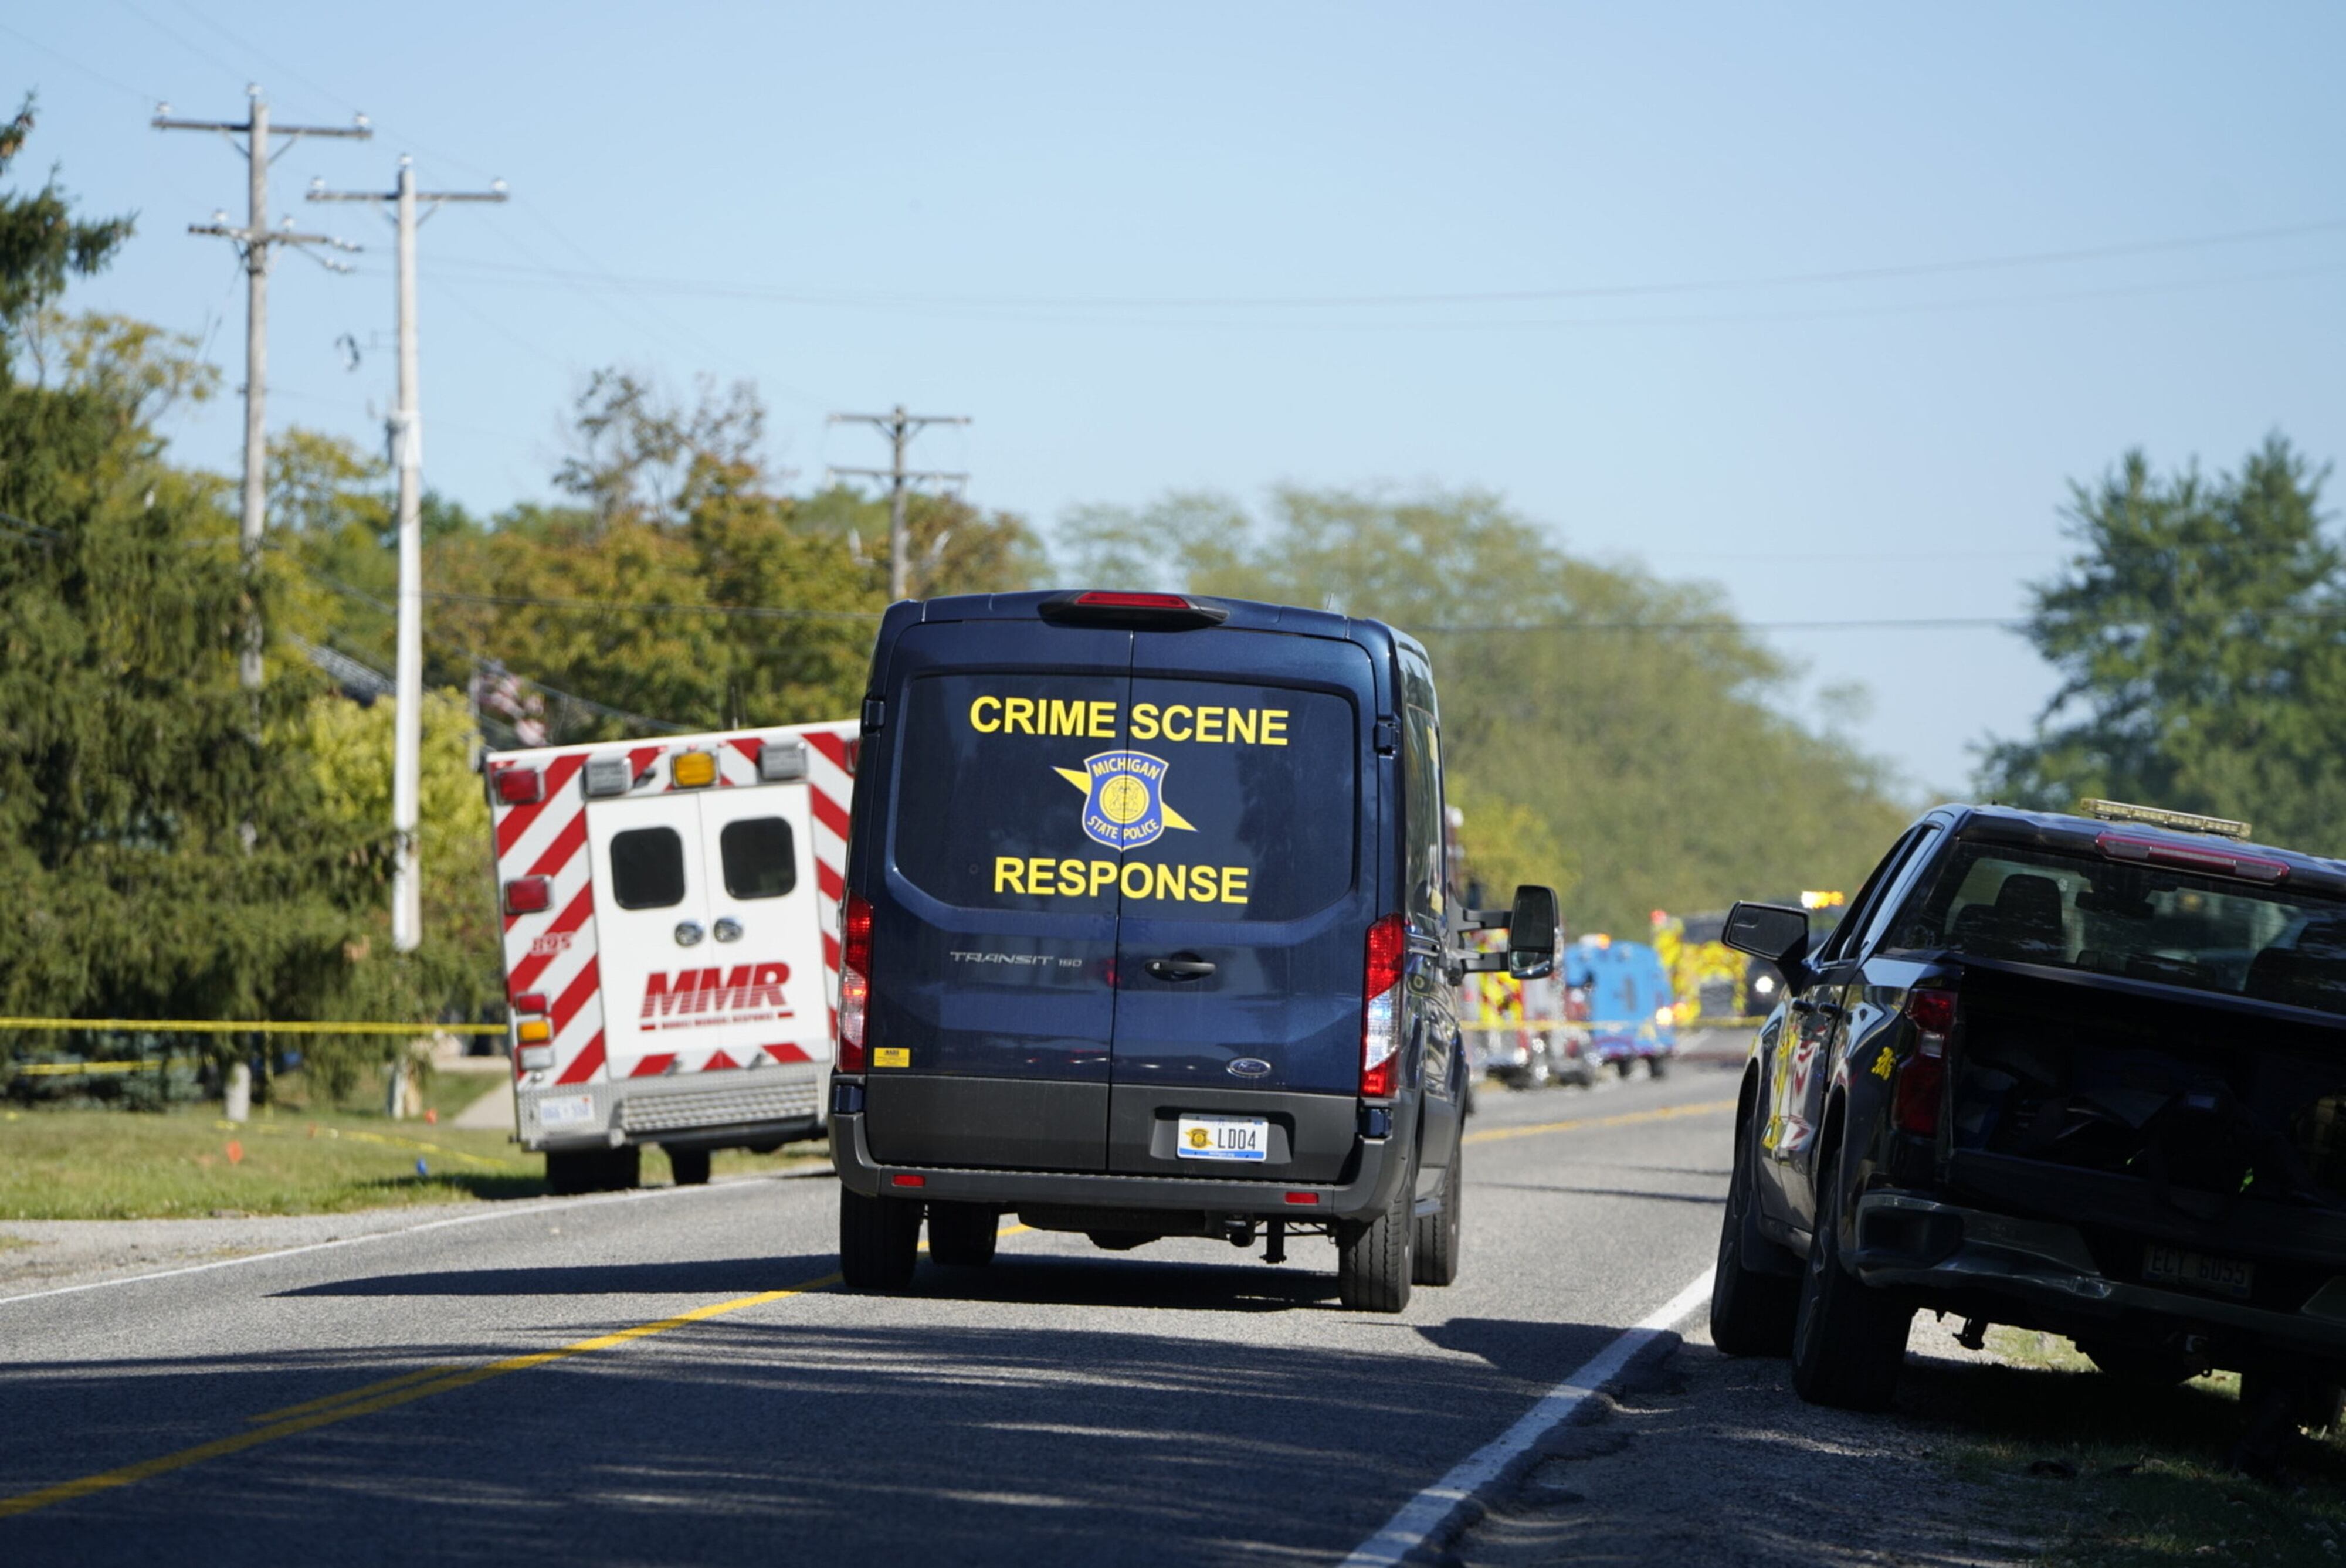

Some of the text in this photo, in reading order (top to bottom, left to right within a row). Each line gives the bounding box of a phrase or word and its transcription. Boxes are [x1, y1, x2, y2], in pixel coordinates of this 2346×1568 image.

[970, 695, 1289, 745] CRIME SCENE
[1092, 758, 1160, 780] MICHIGAN
[1087, 816, 1159, 840] STATE POLICE
[994, 856, 1249, 904] RESPONSE
[950, 951, 1054, 966] TRANSIT
[640, 961, 790, 1018] MMR
[1218, 1128, 1256, 1150] LD04
